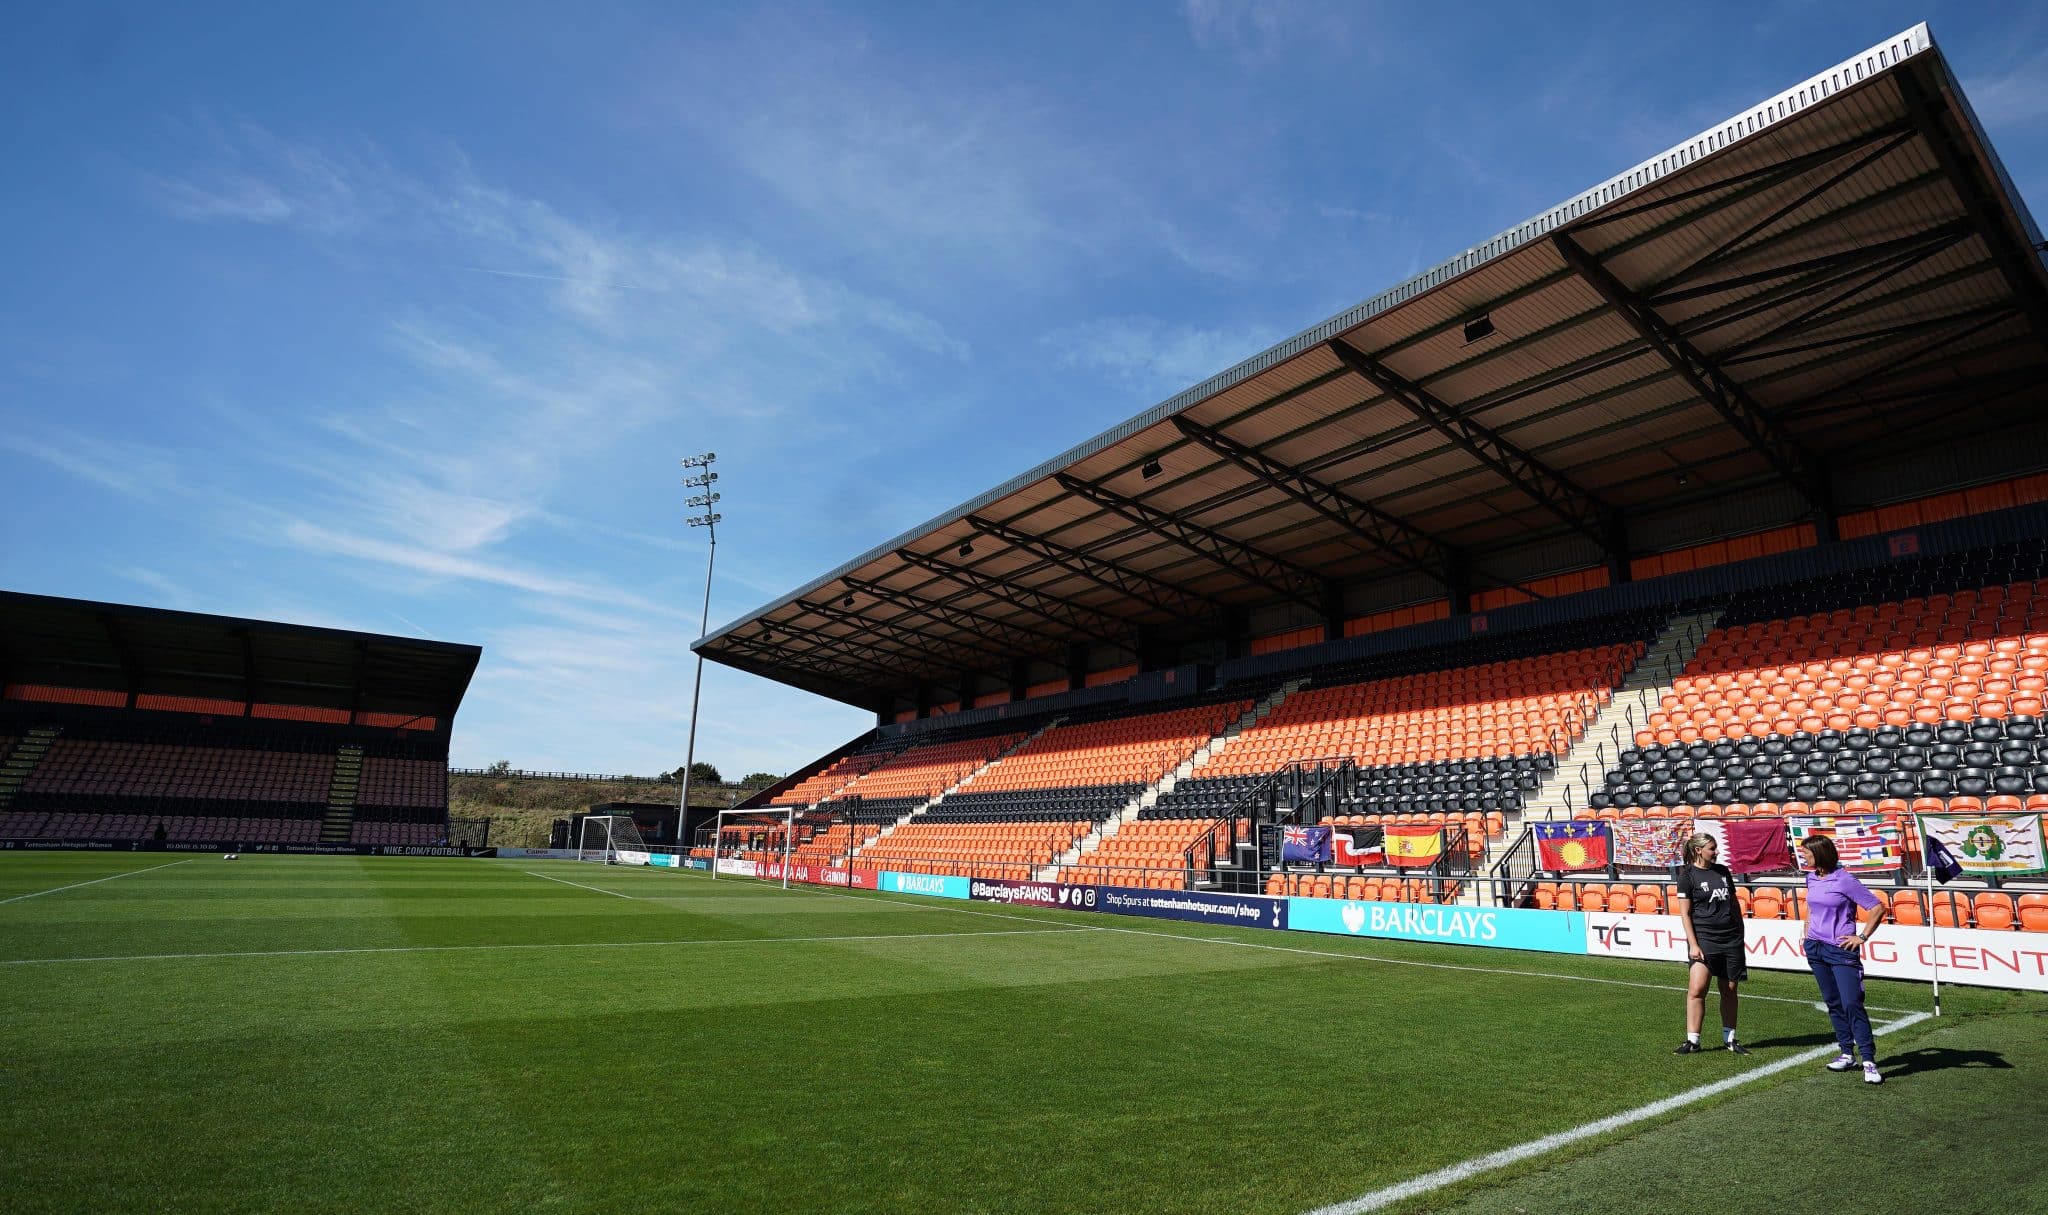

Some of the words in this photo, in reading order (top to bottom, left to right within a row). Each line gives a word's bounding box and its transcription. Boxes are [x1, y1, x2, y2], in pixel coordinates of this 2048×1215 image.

[383, 846, 465, 857] NIKE.COM/FOOTBALL
[769, 864, 780, 878] AIA
[795, 866, 808, 880] AIA
[821, 868, 846, 884] Canon
[905, 876, 944, 893] BARCLAYS
[972, 882, 1055, 903] @BarclaysFAWSL
[1106, 893, 1122, 906] Shop
[1122, 894, 1142, 908] Spurs
[1142, 897, 1150, 907] at
[1150, 897, 1261, 920] tottenhamhotspur.com/shop
[1371, 906, 1497, 940] BARCLAYS
[1644, 929, 1688, 949] TH
